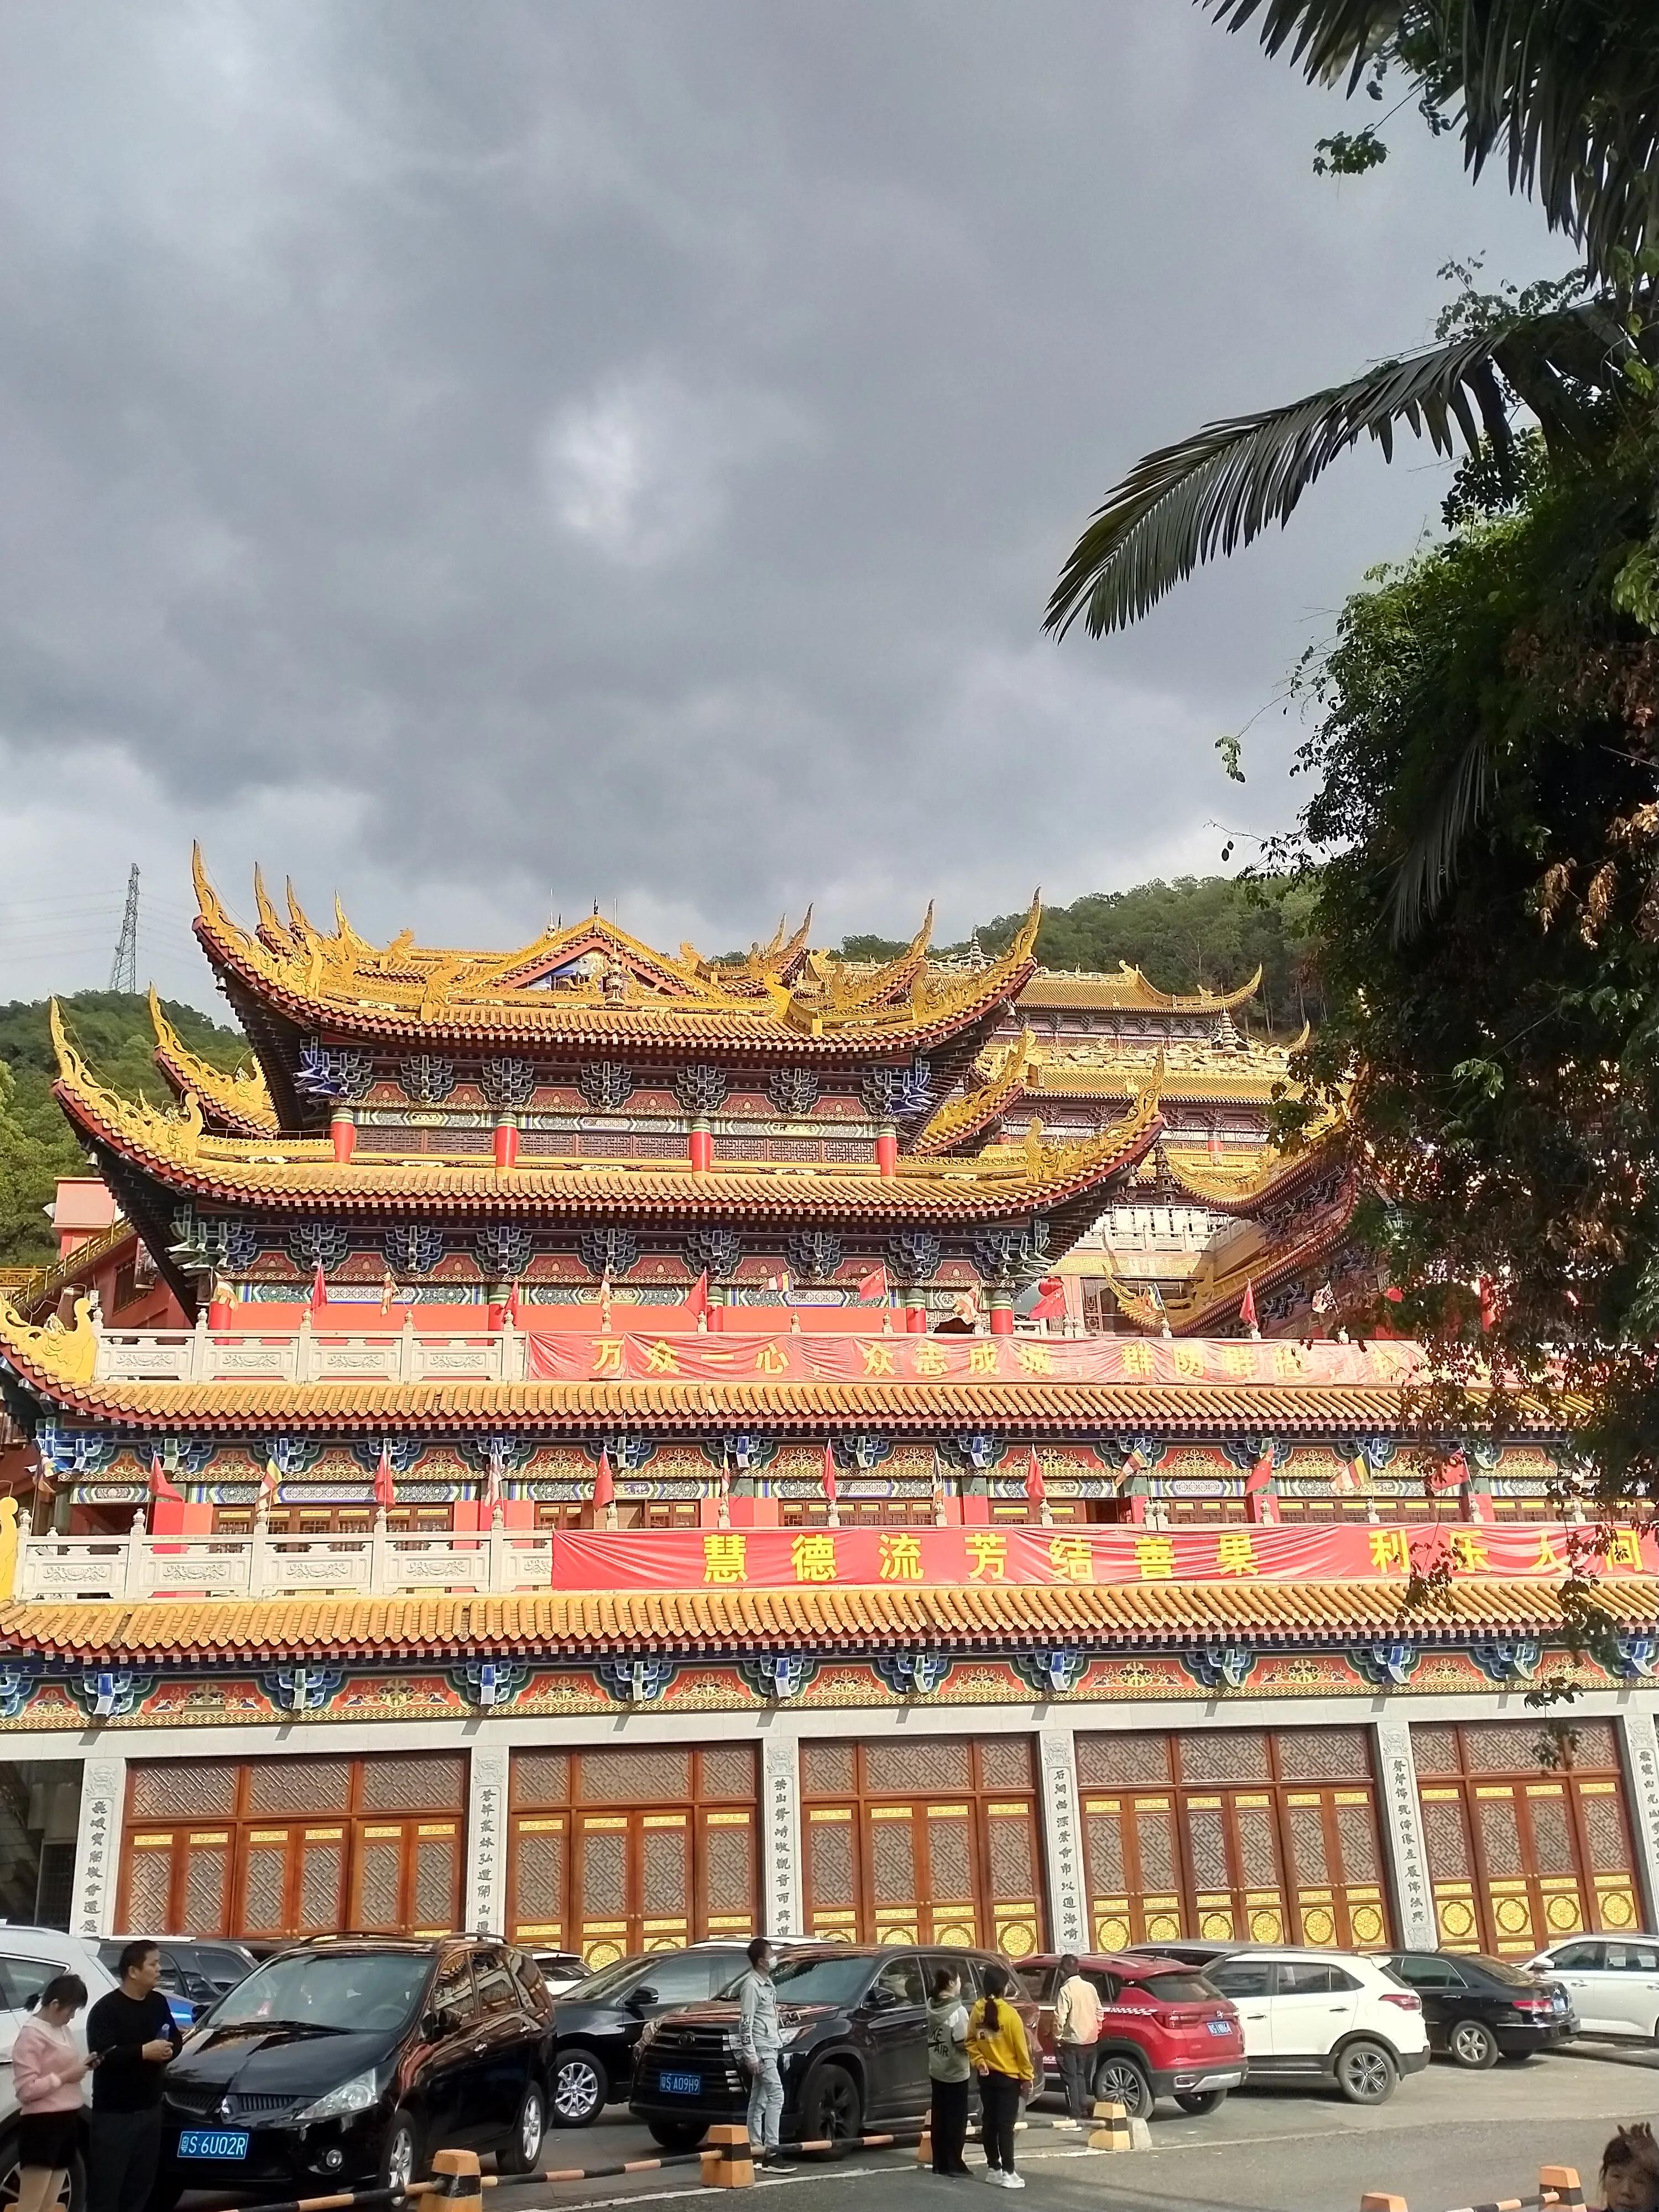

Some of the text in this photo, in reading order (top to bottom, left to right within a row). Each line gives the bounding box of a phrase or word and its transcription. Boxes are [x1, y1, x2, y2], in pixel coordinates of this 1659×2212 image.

[702, 1532, 1259, 1583] 慧德流芳结善果
[933, 2044, 948, 2057] AIR
